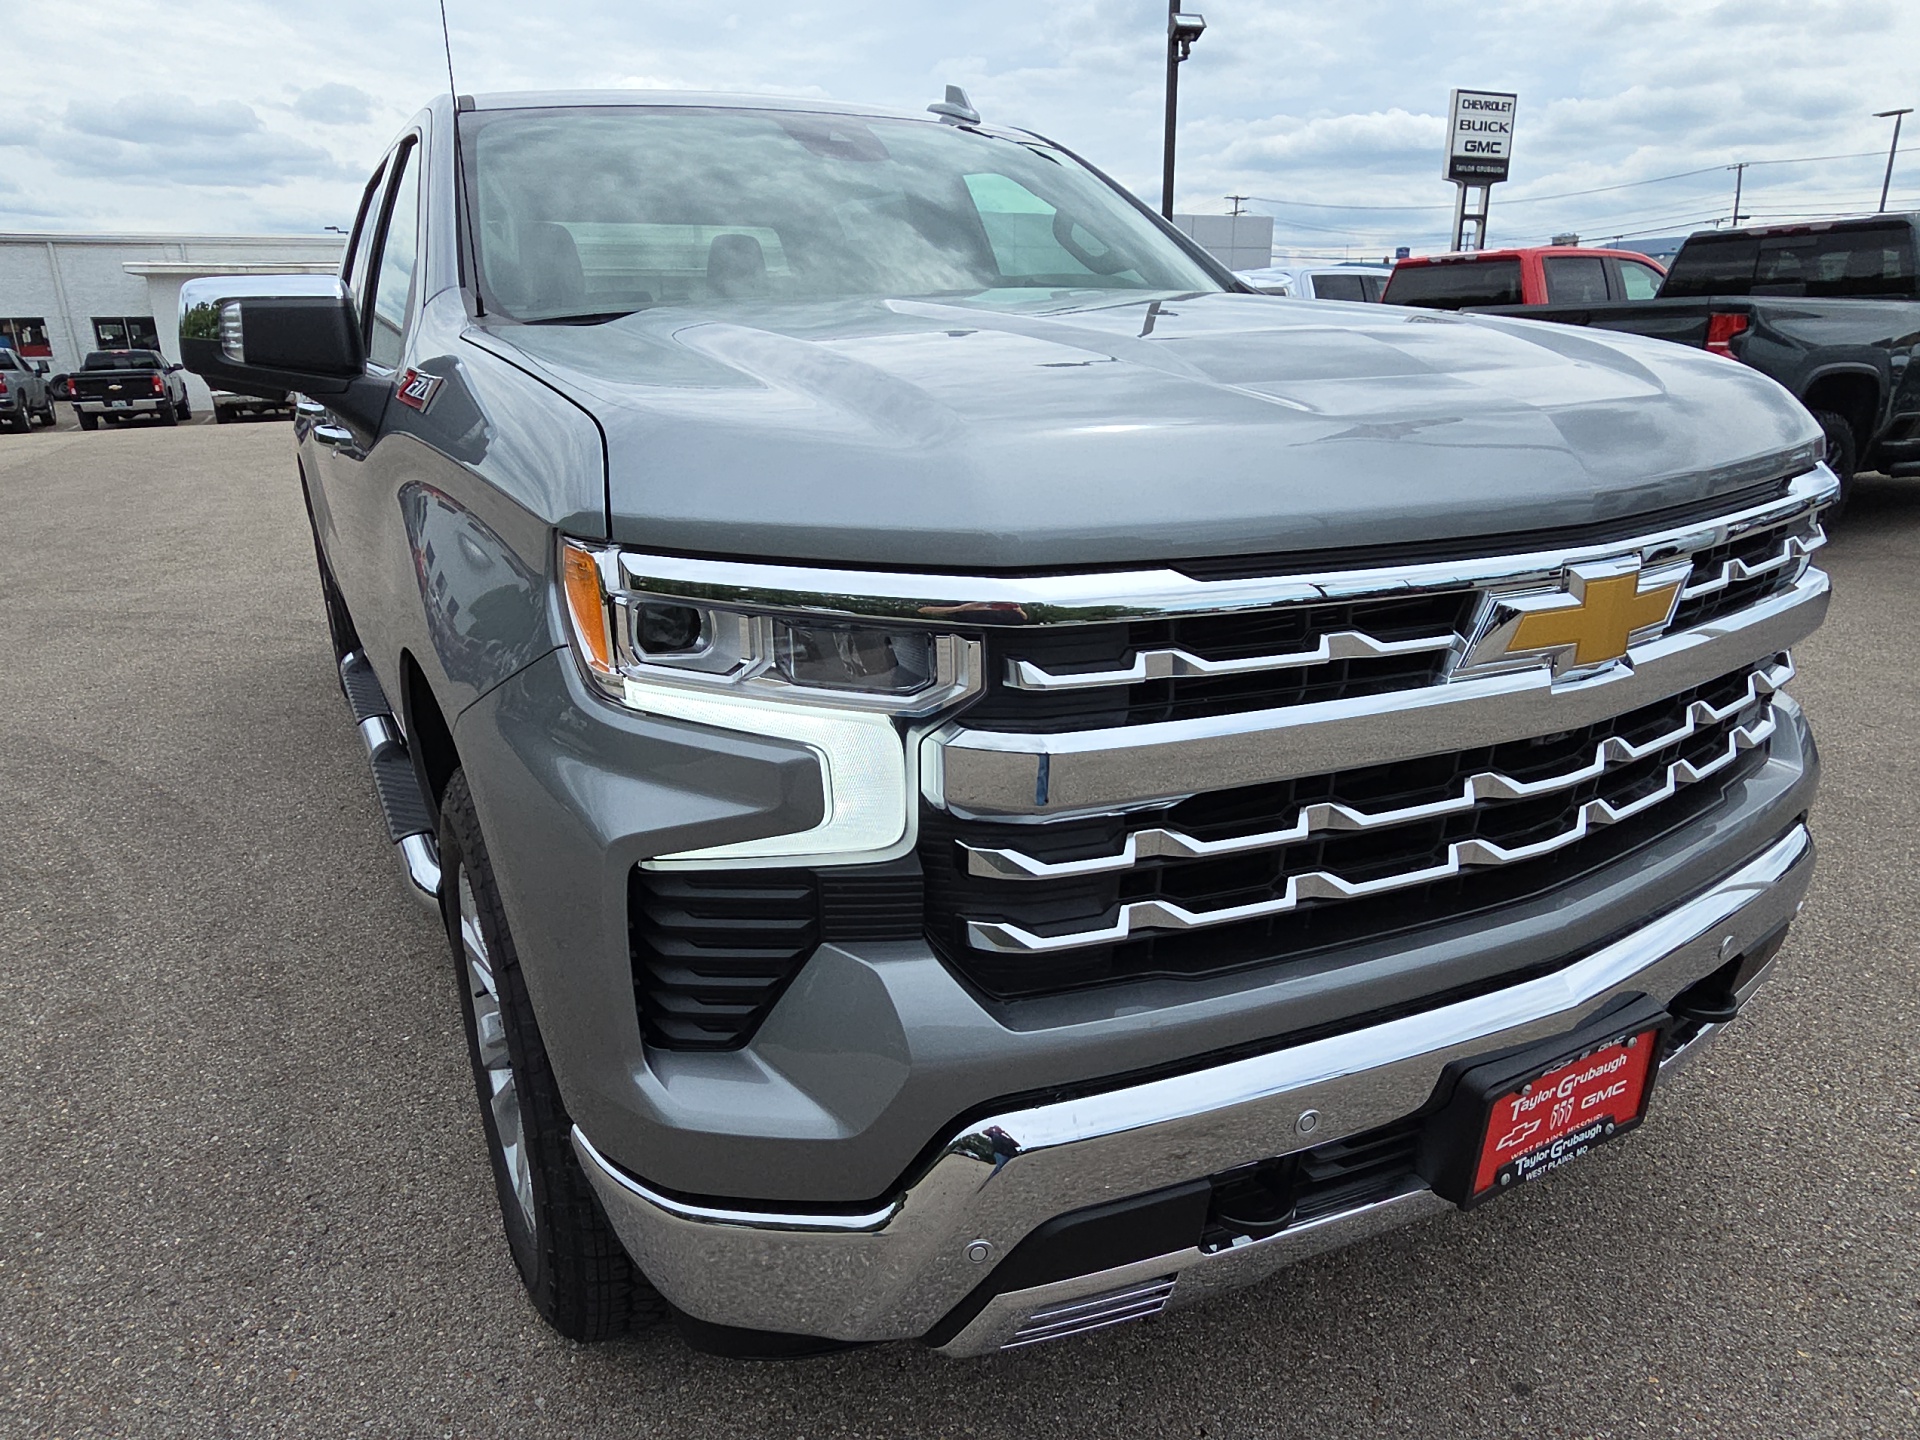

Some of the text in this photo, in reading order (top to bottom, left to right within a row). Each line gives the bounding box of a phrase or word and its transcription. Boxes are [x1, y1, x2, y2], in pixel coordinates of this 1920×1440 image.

[1462, 99, 1512, 112] CHEVROLET
[1459, 119, 1509, 133] BUICK
[1464, 140, 1502, 153] GMC
[1456, 164, 1475, 172] TAYLOR
[395, 366, 434, 411] Z71
[1510, 1054, 1627, 1122] Taylor Grubaugh
[1581, 1080, 1628, 1109] GMC
[1515, 1123, 1602, 1176] Taylor Grubaugh
[1525, 1164, 1547, 1181] WEST
[1576, 1145, 1588, 1157] MO
